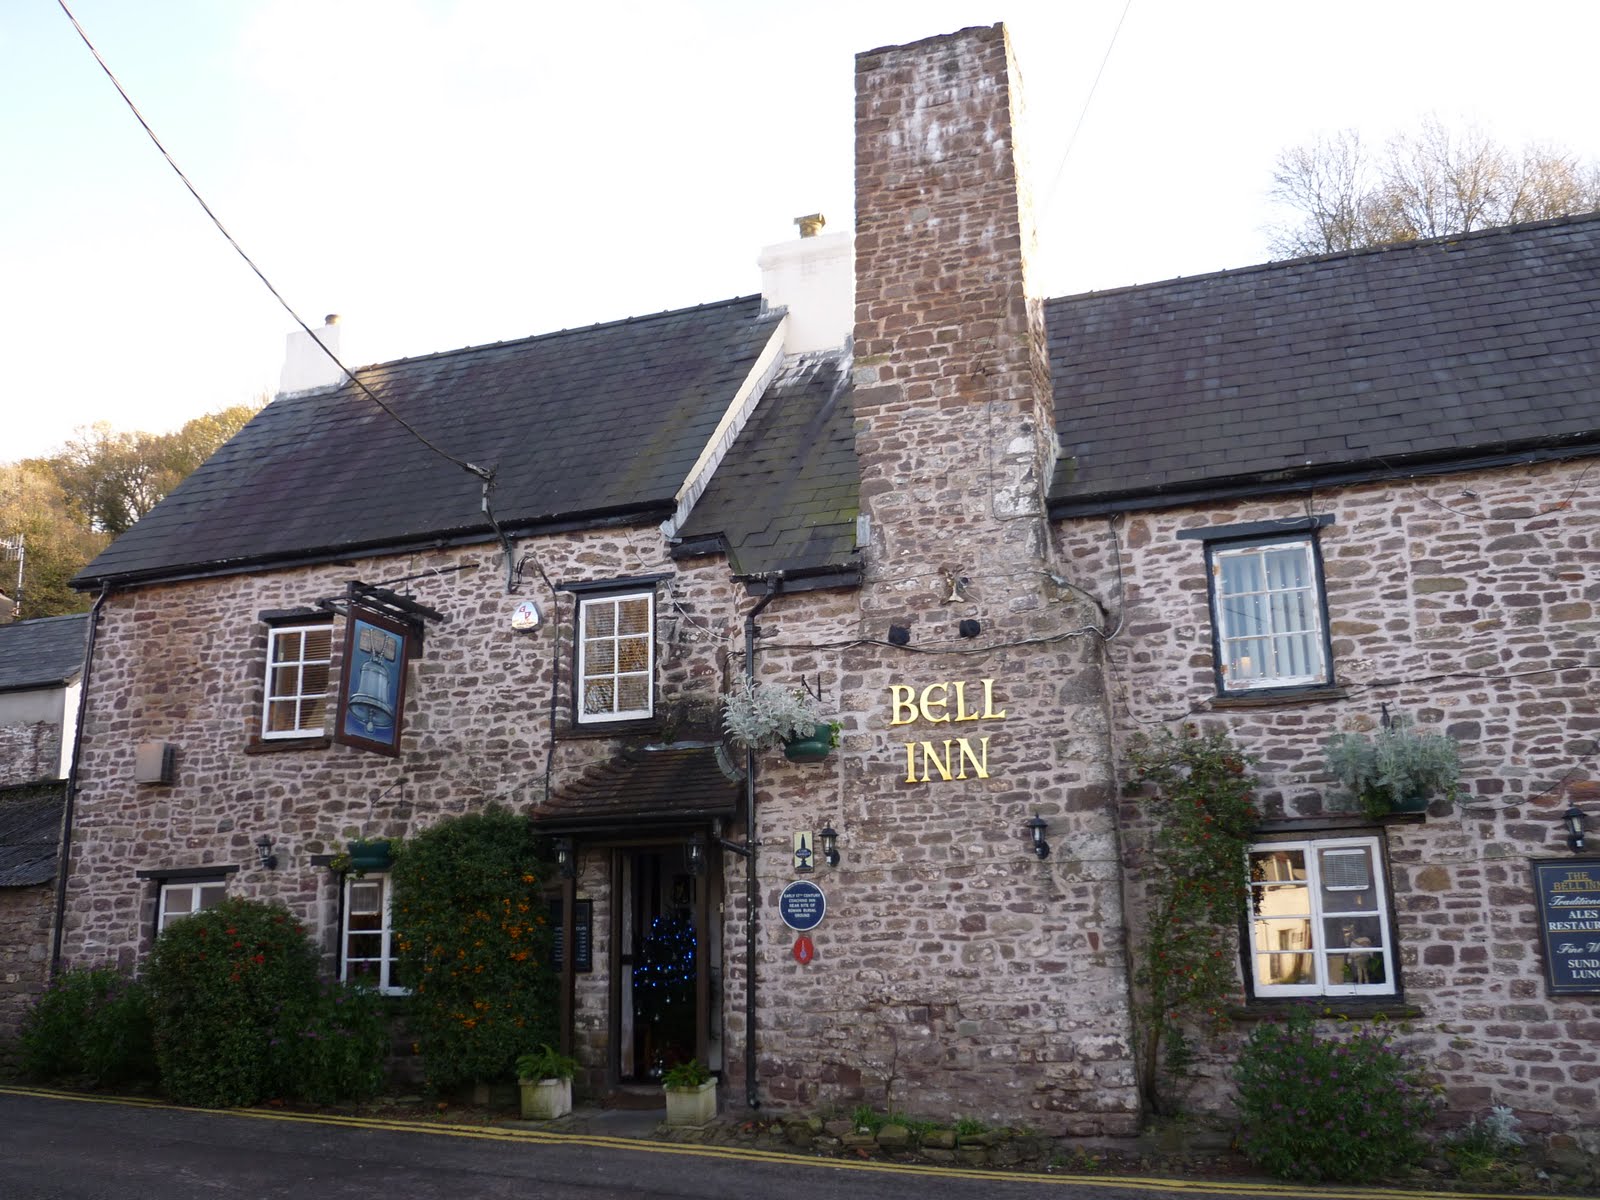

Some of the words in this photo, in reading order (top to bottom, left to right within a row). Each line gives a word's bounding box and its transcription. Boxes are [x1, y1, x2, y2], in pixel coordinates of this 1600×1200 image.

[889, 679, 1006, 725] BELL
[904, 737, 989, 783] INN
[1565, 872, 1589, 880] THE
[1553, 881, 1583, 891] BELL
[1568, 910, 1599, 919] ALES
[1556, 943, 1584, 954] Fine
[1568, 959, 1600, 968] SUND
